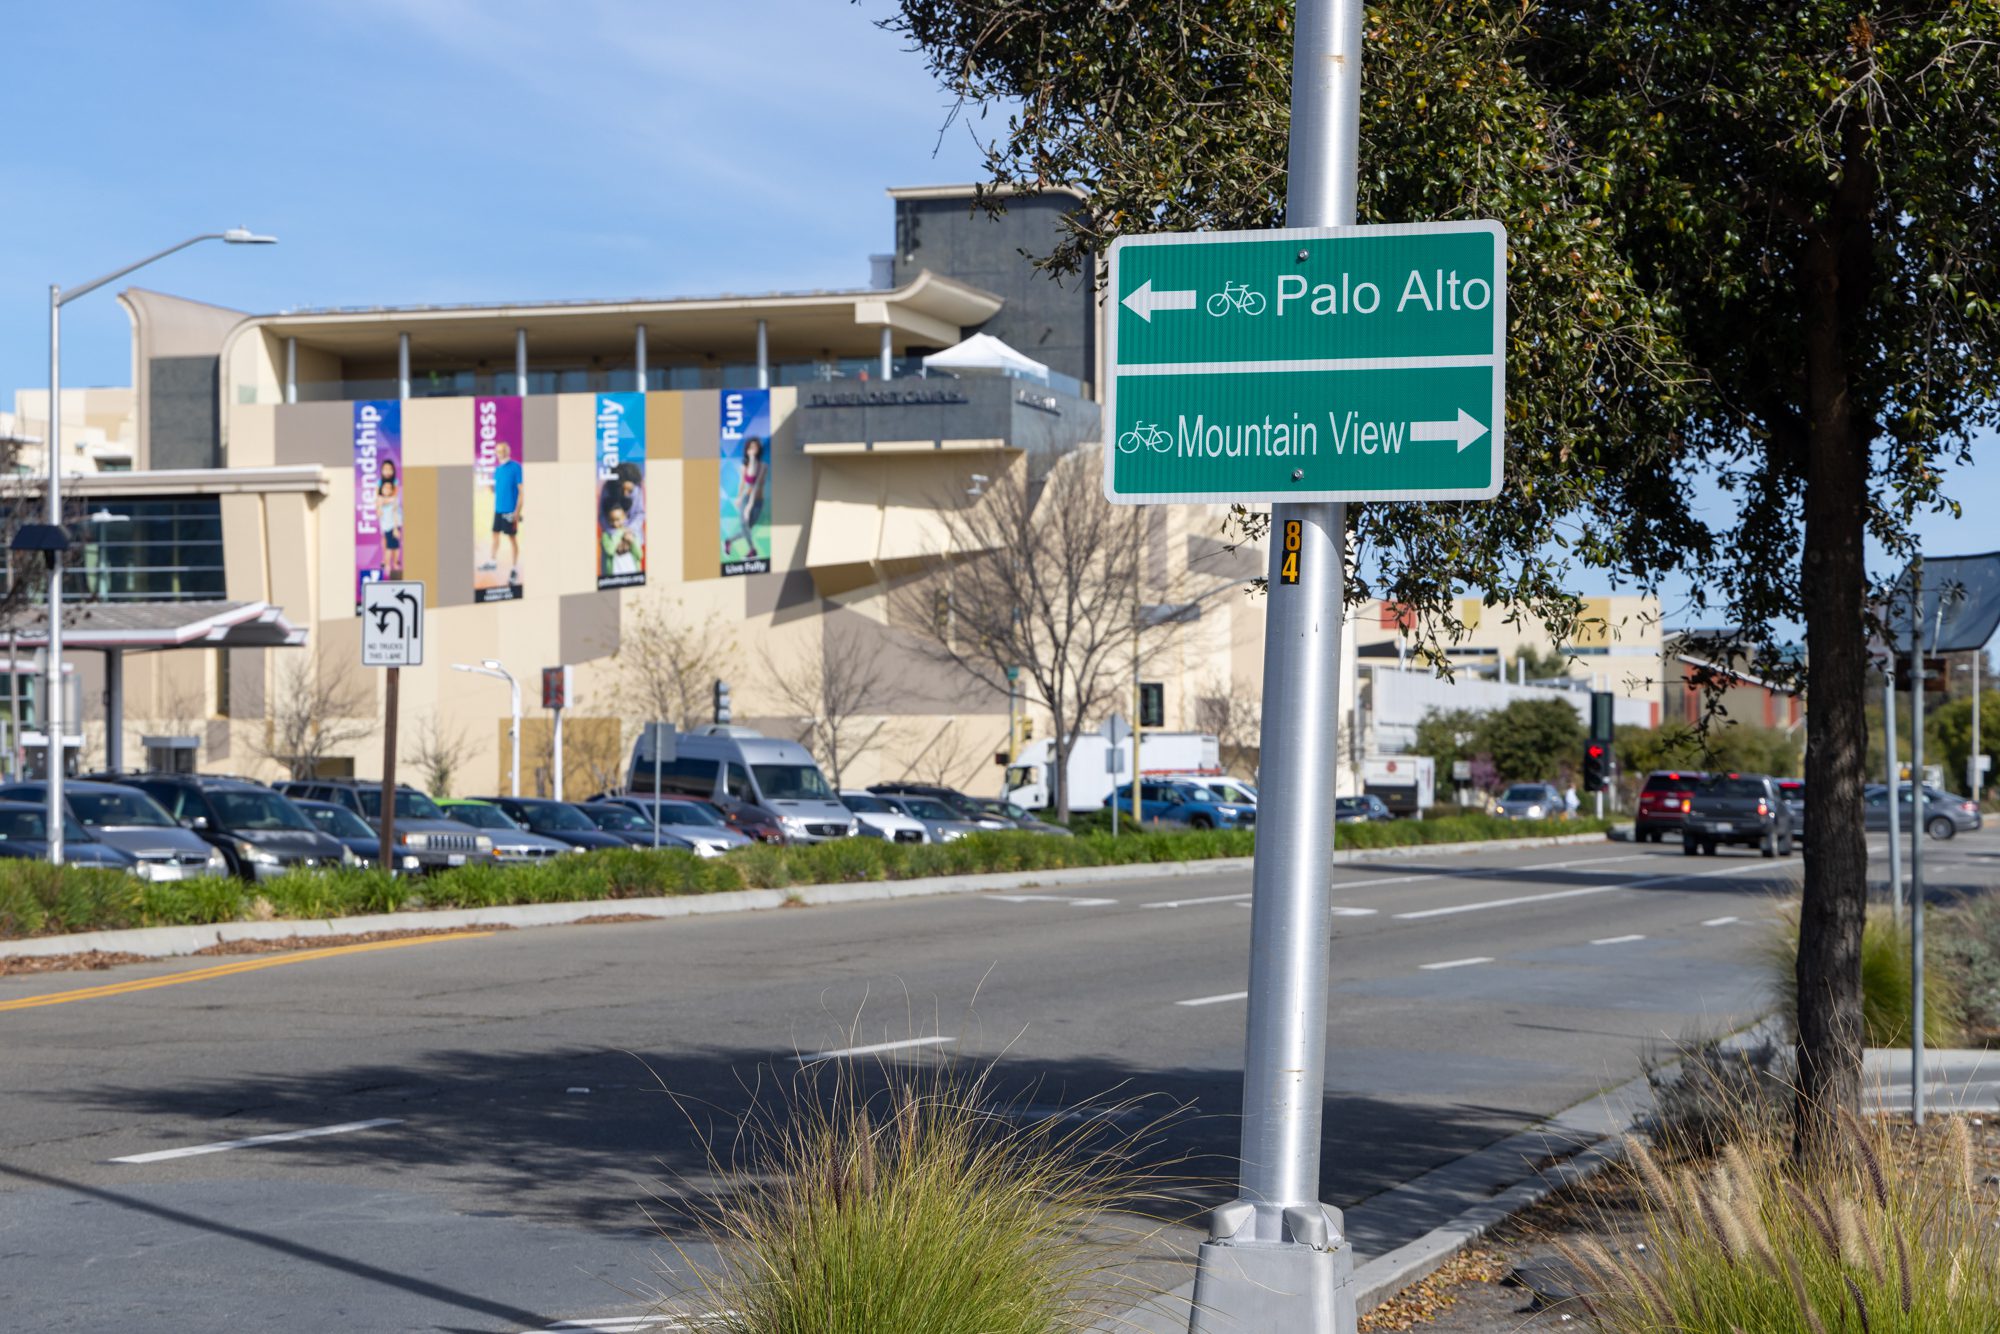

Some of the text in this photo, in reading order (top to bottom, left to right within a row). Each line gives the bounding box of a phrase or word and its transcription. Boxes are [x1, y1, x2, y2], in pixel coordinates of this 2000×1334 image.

[1276, 268, 1491, 316] Palo Alto
[476, 400, 497, 488] Fitness
[598, 398, 624, 480] Family
[722, 393, 743, 441] Fun
[1177, 410, 1406, 458] Mountain View
[356, 404, 382, 534] Friendship
